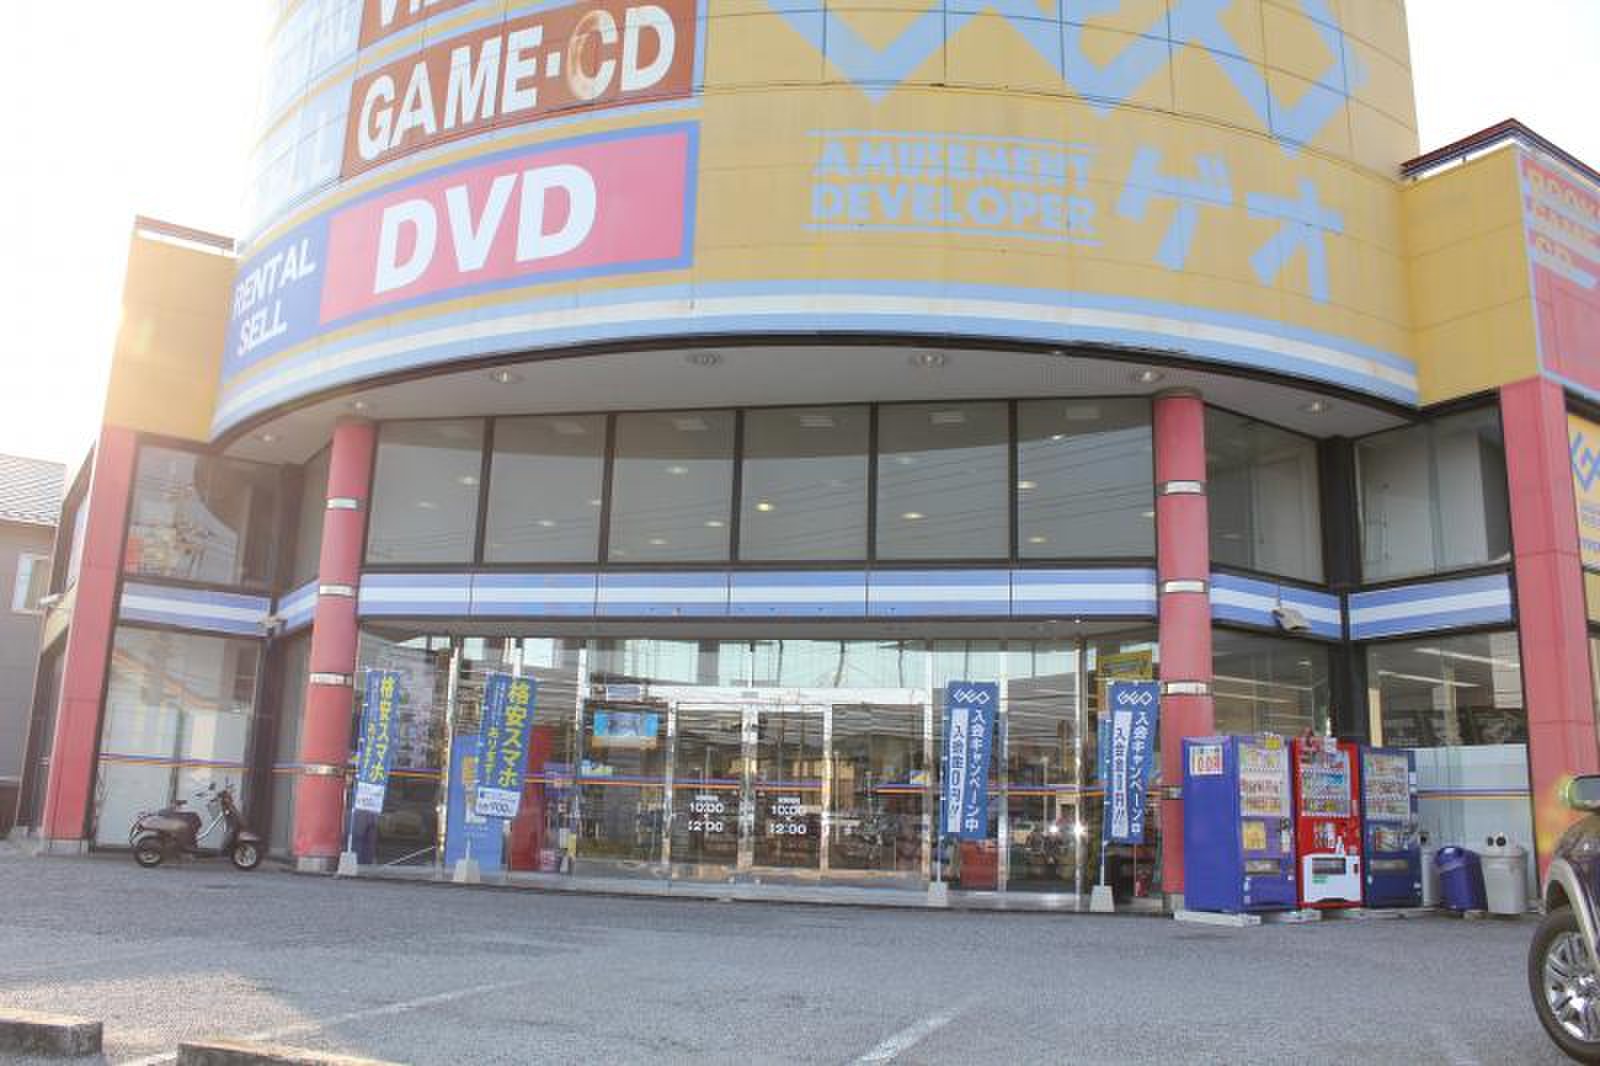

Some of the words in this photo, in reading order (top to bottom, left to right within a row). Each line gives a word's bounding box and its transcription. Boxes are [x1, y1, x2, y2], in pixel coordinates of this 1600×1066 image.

[813, 140, 1090, 191] AMUSEMENT
[373, 163, 597, 295] DVD
[811, 182, 1097, 233] DEVELOPER
[1115, 144, 1345, 305] ゲオ
[232, 237, 316, 321] RENTAL
[237, 299, 287, 357] SELL
[498, 681, 530, 788] 格安スマホ
[689, 801, 725, 814] 10:00
[771, 804, 807, 816] 10:00
